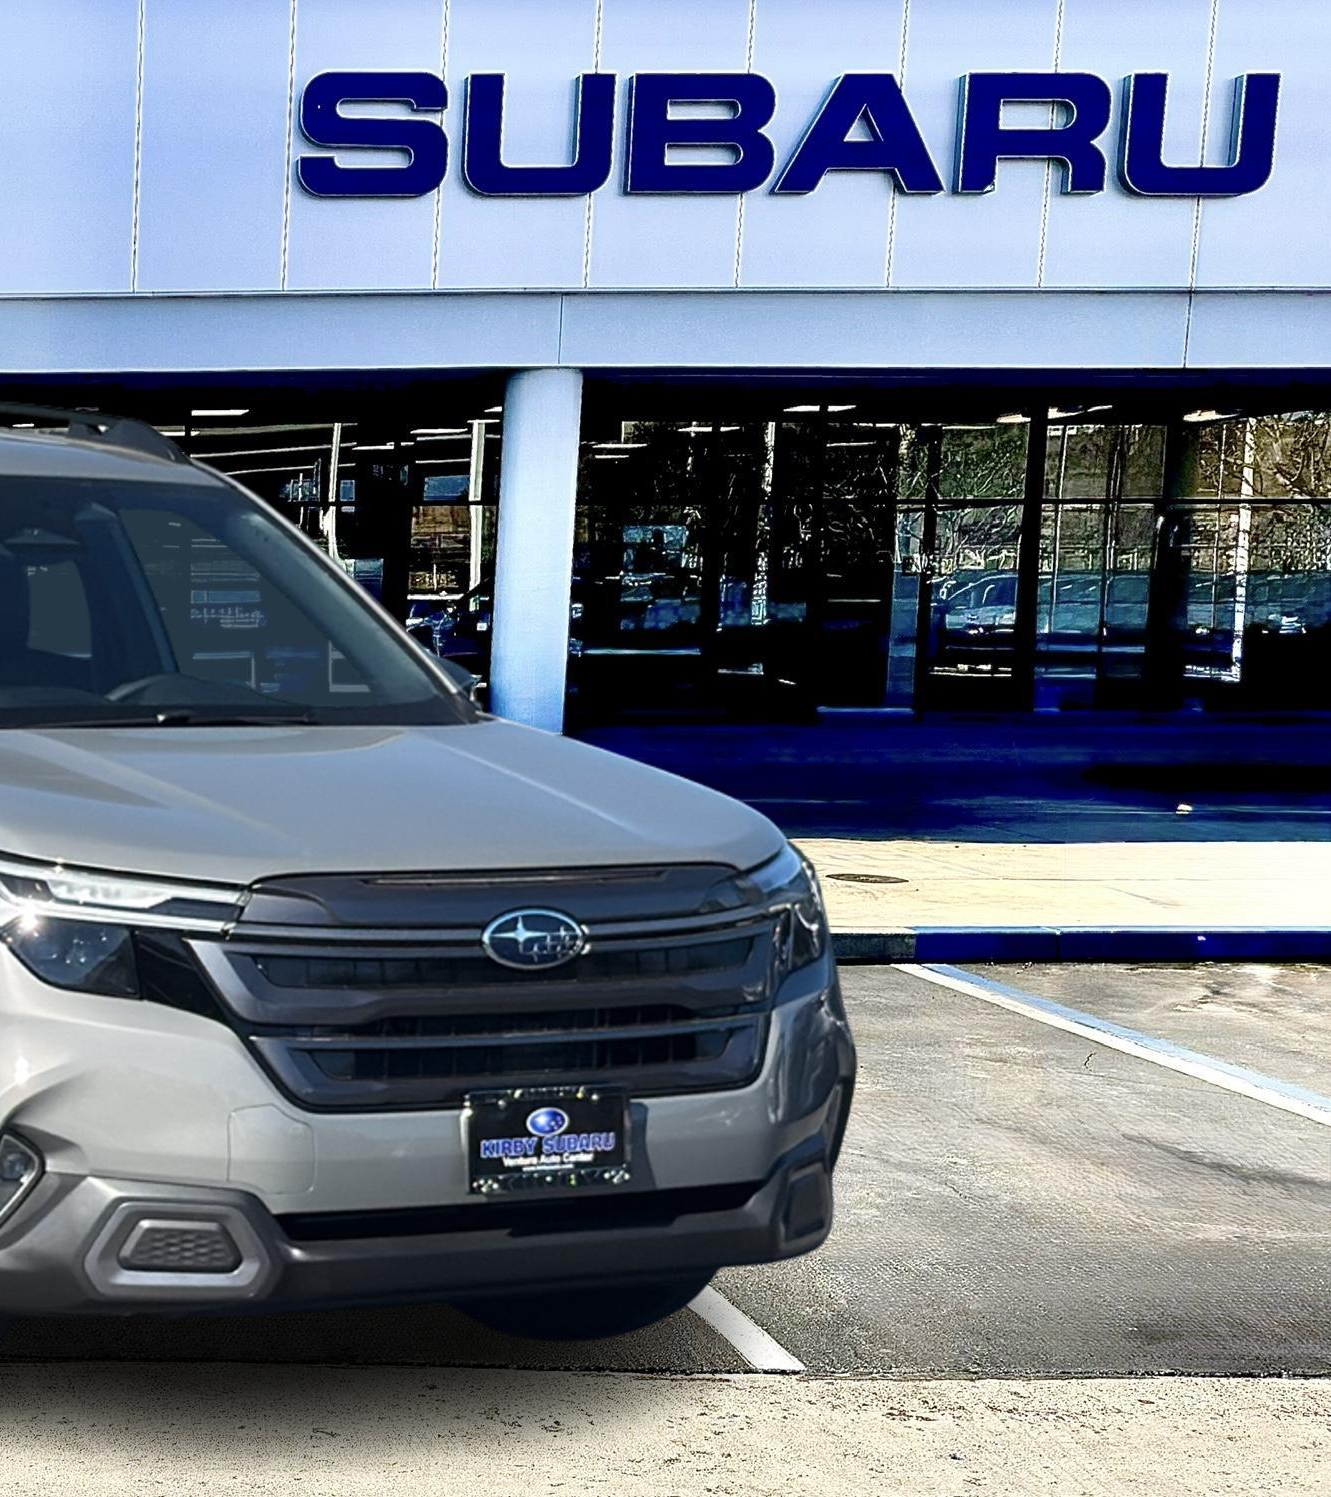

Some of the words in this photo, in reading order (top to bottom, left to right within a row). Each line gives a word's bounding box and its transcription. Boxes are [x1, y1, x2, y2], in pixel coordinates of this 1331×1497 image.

[296, 70, 1282, 198] SUBARU
[481, 1138, 538, 1158] KIRBY
[543, 1132, 615, 1153] SUBARU
[502, 1155, 538, 1167] Ventura
[539, 1153, 561, 1164] Auto
[563, 1152, 594, 1162] Center
